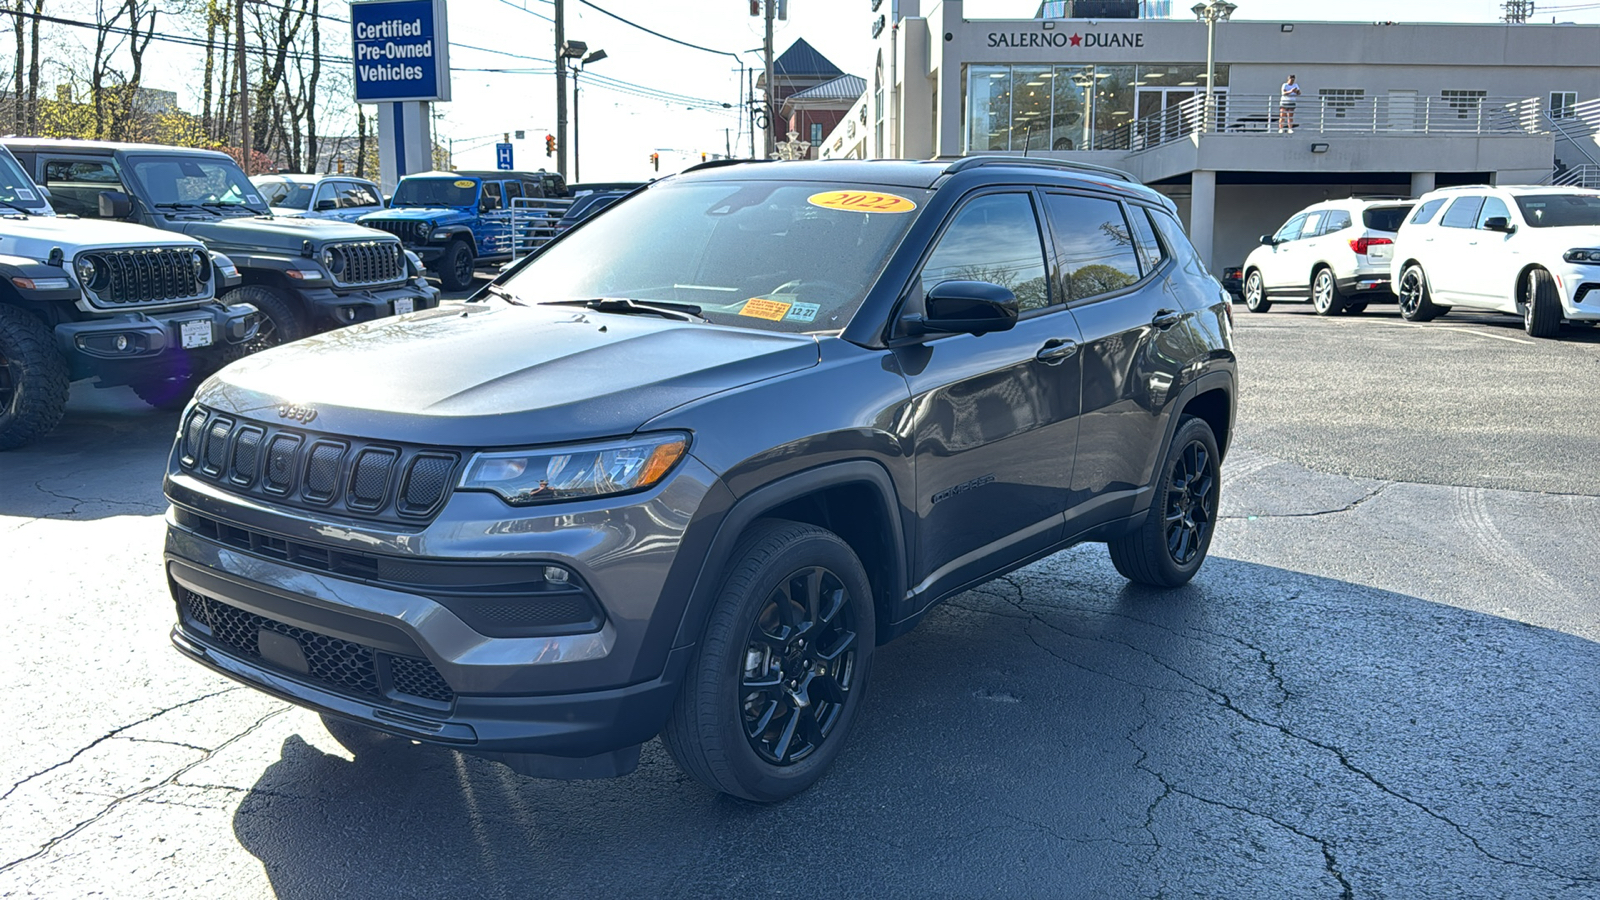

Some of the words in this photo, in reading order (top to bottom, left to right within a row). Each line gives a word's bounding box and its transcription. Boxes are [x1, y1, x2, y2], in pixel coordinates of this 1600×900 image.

[356, 18, 421, 39] Certified
[987, 32, 1067, 47] SALERNO
[1084, 33, 1144, 47] DUANE
[357, 40, 432, 60] Pre-Owned
[359, 63, 423, 82] Vehicles
[500, 149, 510, 162] H
[822, 194, 901, 209] 2022
[790, 307, 803, 316] 12
[803, 308, 815, 317] 27
[279, 404, 318, 425] Jeep
